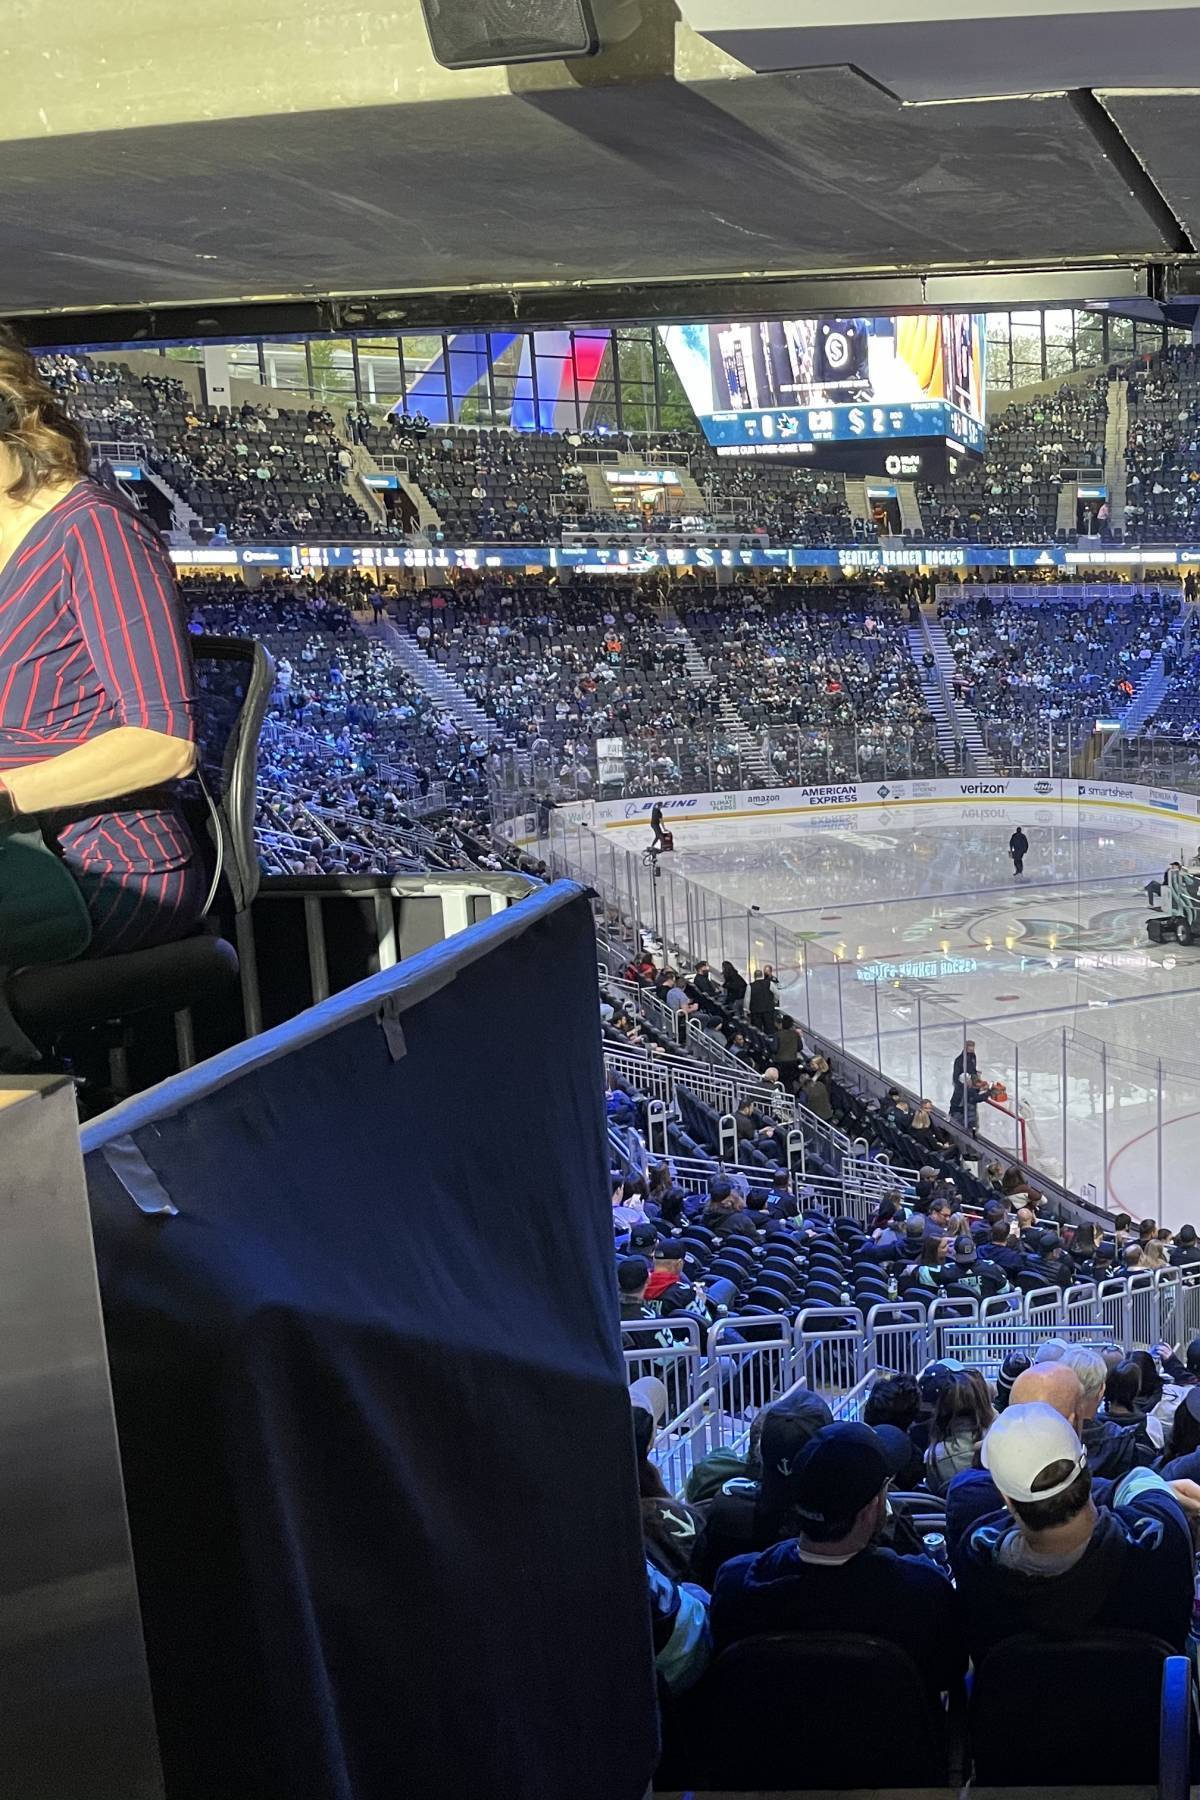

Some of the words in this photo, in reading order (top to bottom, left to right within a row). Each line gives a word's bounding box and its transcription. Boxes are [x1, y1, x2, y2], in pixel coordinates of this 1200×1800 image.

[882, 549, 922, 565] KRAKEN
[801, 786, 857, 798] AMERICAN
[960, 782, 1004, 795] verizon
[1088, 786, 1134, 799] smartsheet
[809, 794, 858, 805] EXPRESS
